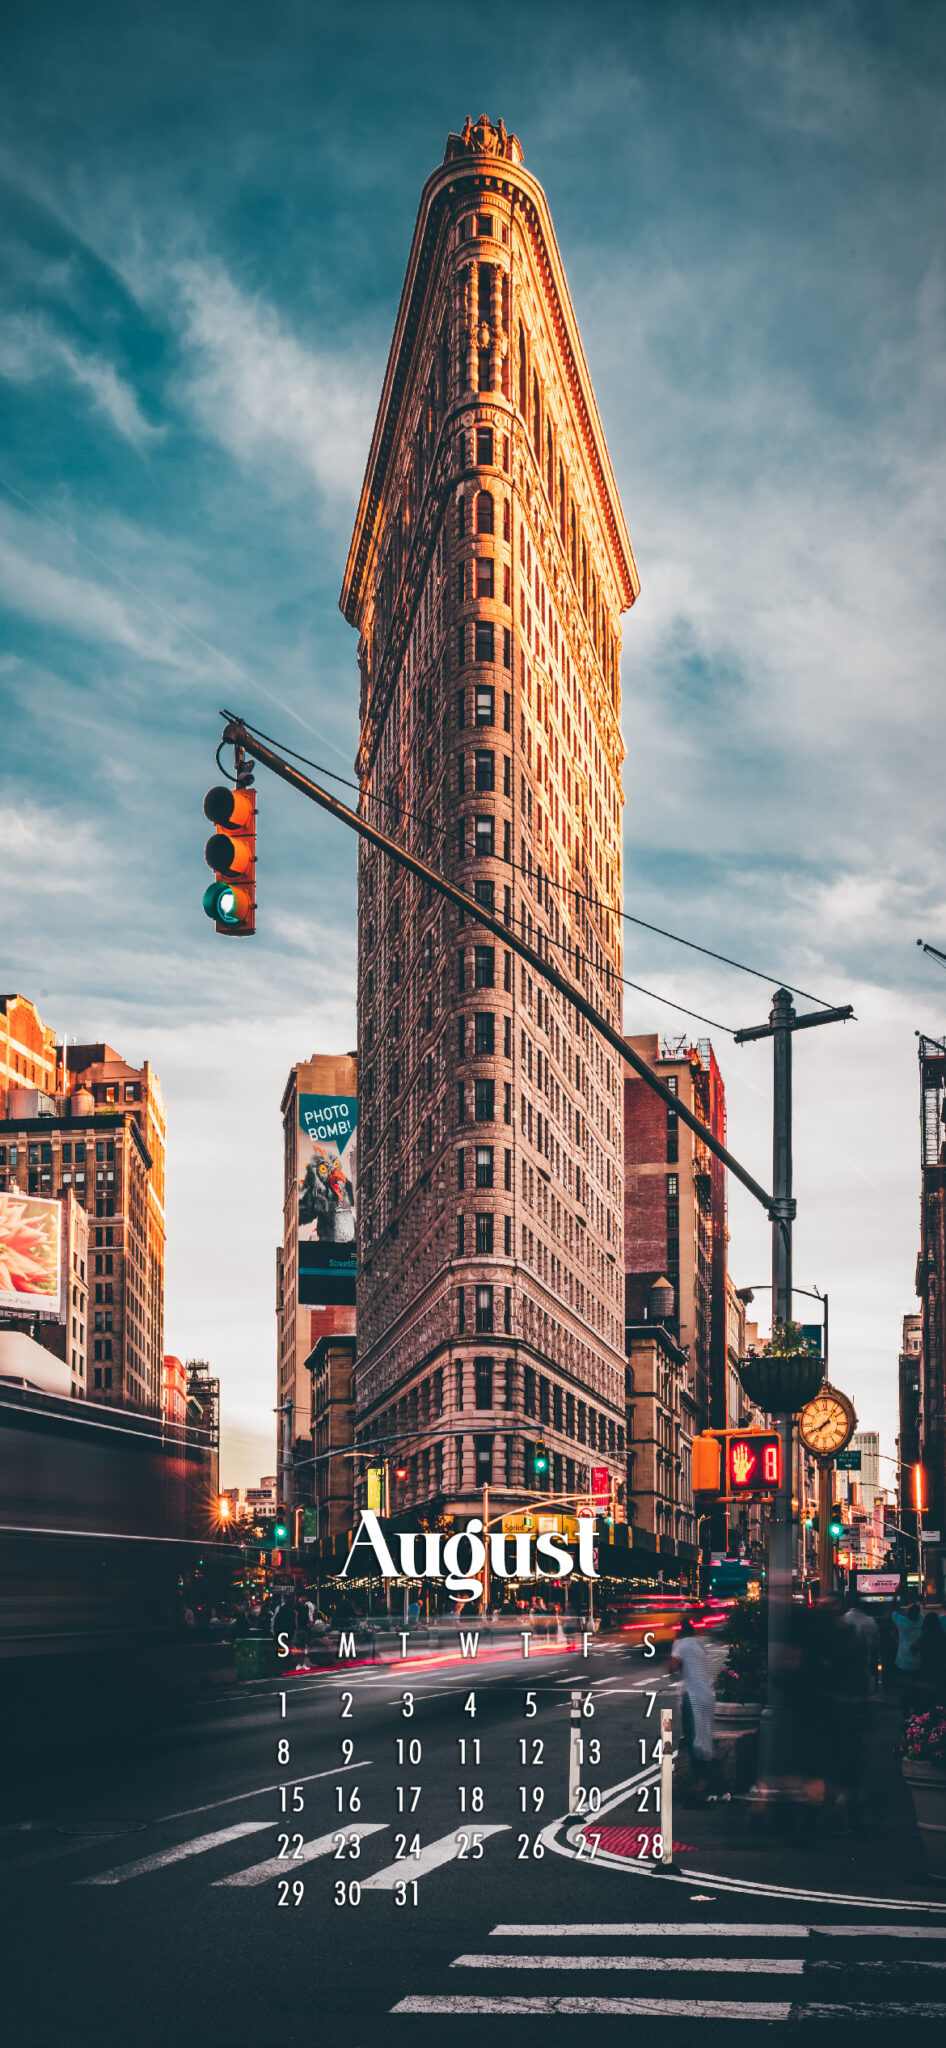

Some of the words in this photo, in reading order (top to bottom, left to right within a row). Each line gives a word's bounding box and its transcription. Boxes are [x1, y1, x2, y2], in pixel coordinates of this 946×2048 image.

[304, 1103, 349, 1125] PHOTO
[308, 1120, 352, 1141] BOMB!
[505, 1524, 525, 1532] Sprint
